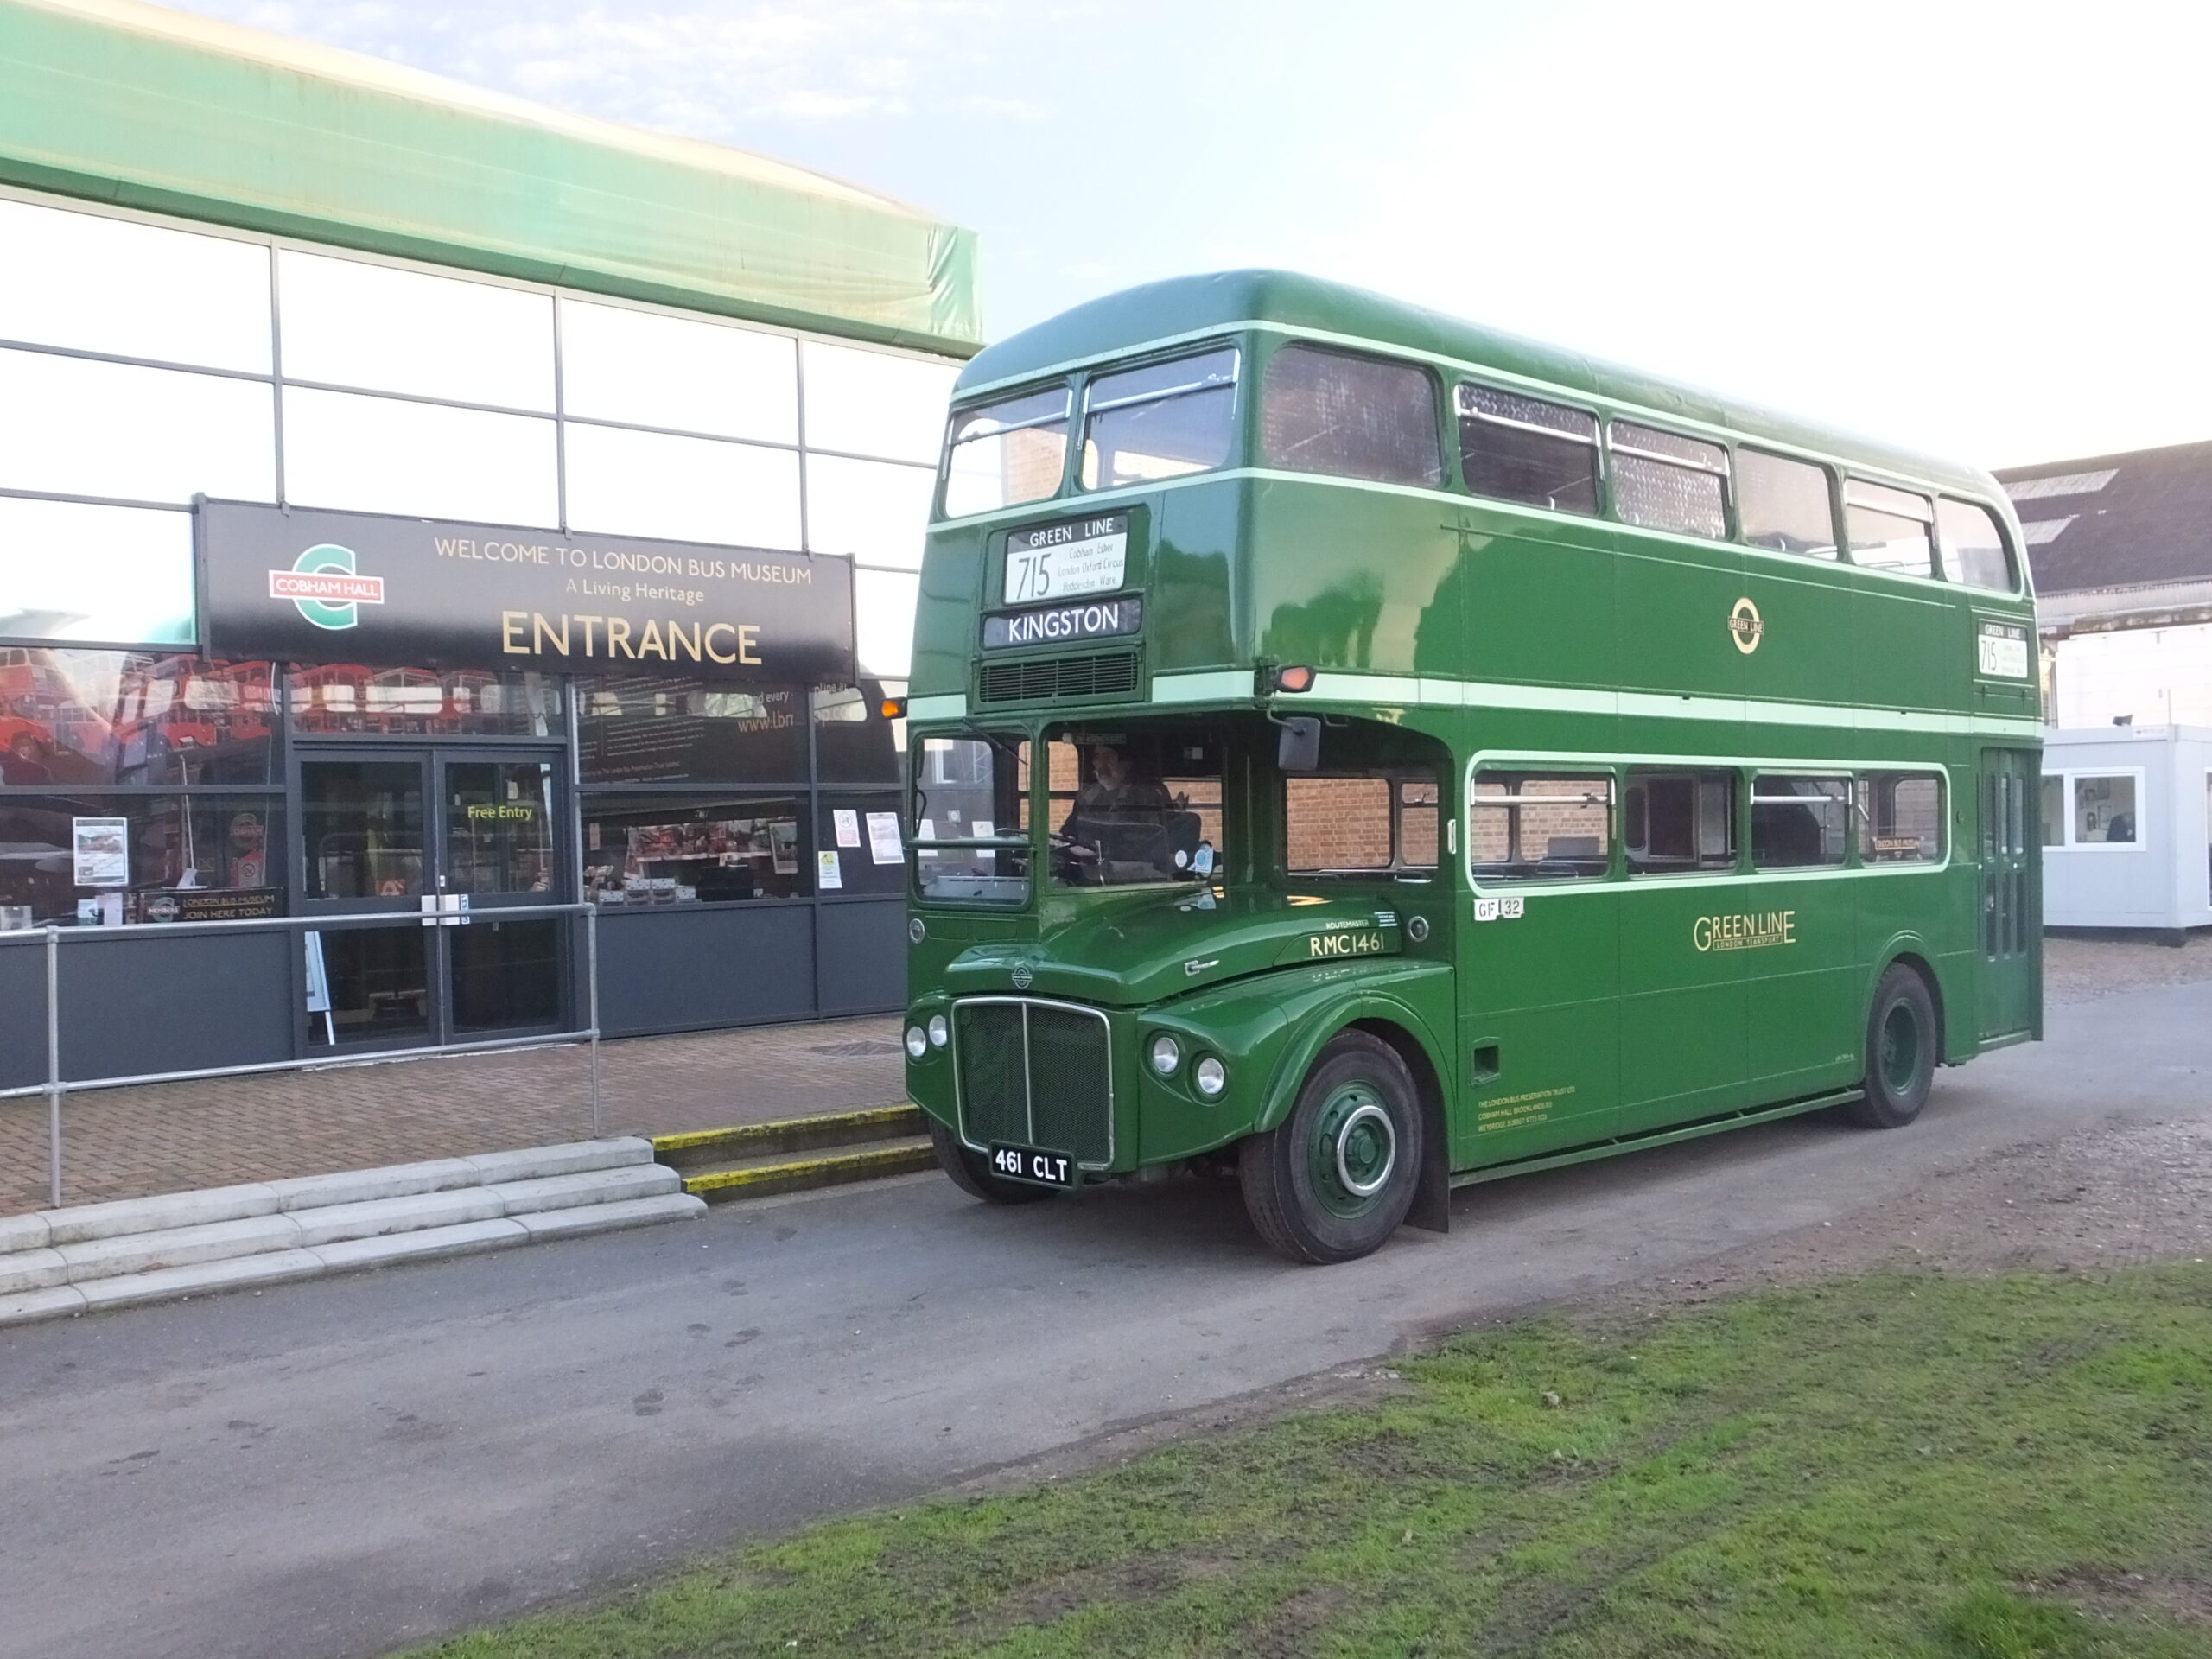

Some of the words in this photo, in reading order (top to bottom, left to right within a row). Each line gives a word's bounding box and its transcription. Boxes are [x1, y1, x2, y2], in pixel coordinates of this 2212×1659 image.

[1030, 526, 1072, 547] GREEN
[1085, 518, 1114, 537] LINE
[434, 537, 550, 564] WELCOME
[556, 547, 587, 566] TO
[593, 550, 682, 575] LONDON
[689, 559, 725, 578] BUS
[731, 563, 812, 585] MUSEUM
[1058, 565, 1080, 577] London
[1103, 557, 1123, 569] Circus
[1017, 553, 1052, 600] 715
[1100, 575, 1116, 586] Ware
[275, 577, 341, 595] COBHAM
[343, 582, 378, 597] HALL
[566, 578, 577, 593] A
[583, 579, 631, 601] Living
[635, 582, 704, 606] Heritage
[1009, 603, 1119, 642] KINGSTON
[1985, 624, 2004, 636] GREEN
[2008, 628, 2020, 639] LINE
[502, 610, 762, 664] ENTRANCE
[1981, 640, 1997, 671] 715
[766, 691, 790, 704] every
[467, 806, 495, 818] Free
[499, 806, 532, 821] Entry
[183, 898, 219, 907] LONDON
[220, 896, 236, 906] BUS
[238, 895, 275, 905] MUSEUM
[1478, 902, 1495, 917] GF
[183, 910, 207, 919] JOIN
[211, 909, 235, 918] HERE
[239, 907, 272, 917] TODAY
[1325, 919, 1370, 931] ROUTEMASTER
[1694, 914, 1755, 951] GREEN
[1758, 911, 1796, 943] LINE
[1310, 932, 1384, 957] RMC1461
[1717, 938, 1743, 949] LONDON
[1746, 936, 1779, 945] TRANSPORT
[1487, 1097, 1510, 1107] LONDON
[995, 1149, 1021, 1174] 461
[1033, 1156, 1067, 1181] CLT
